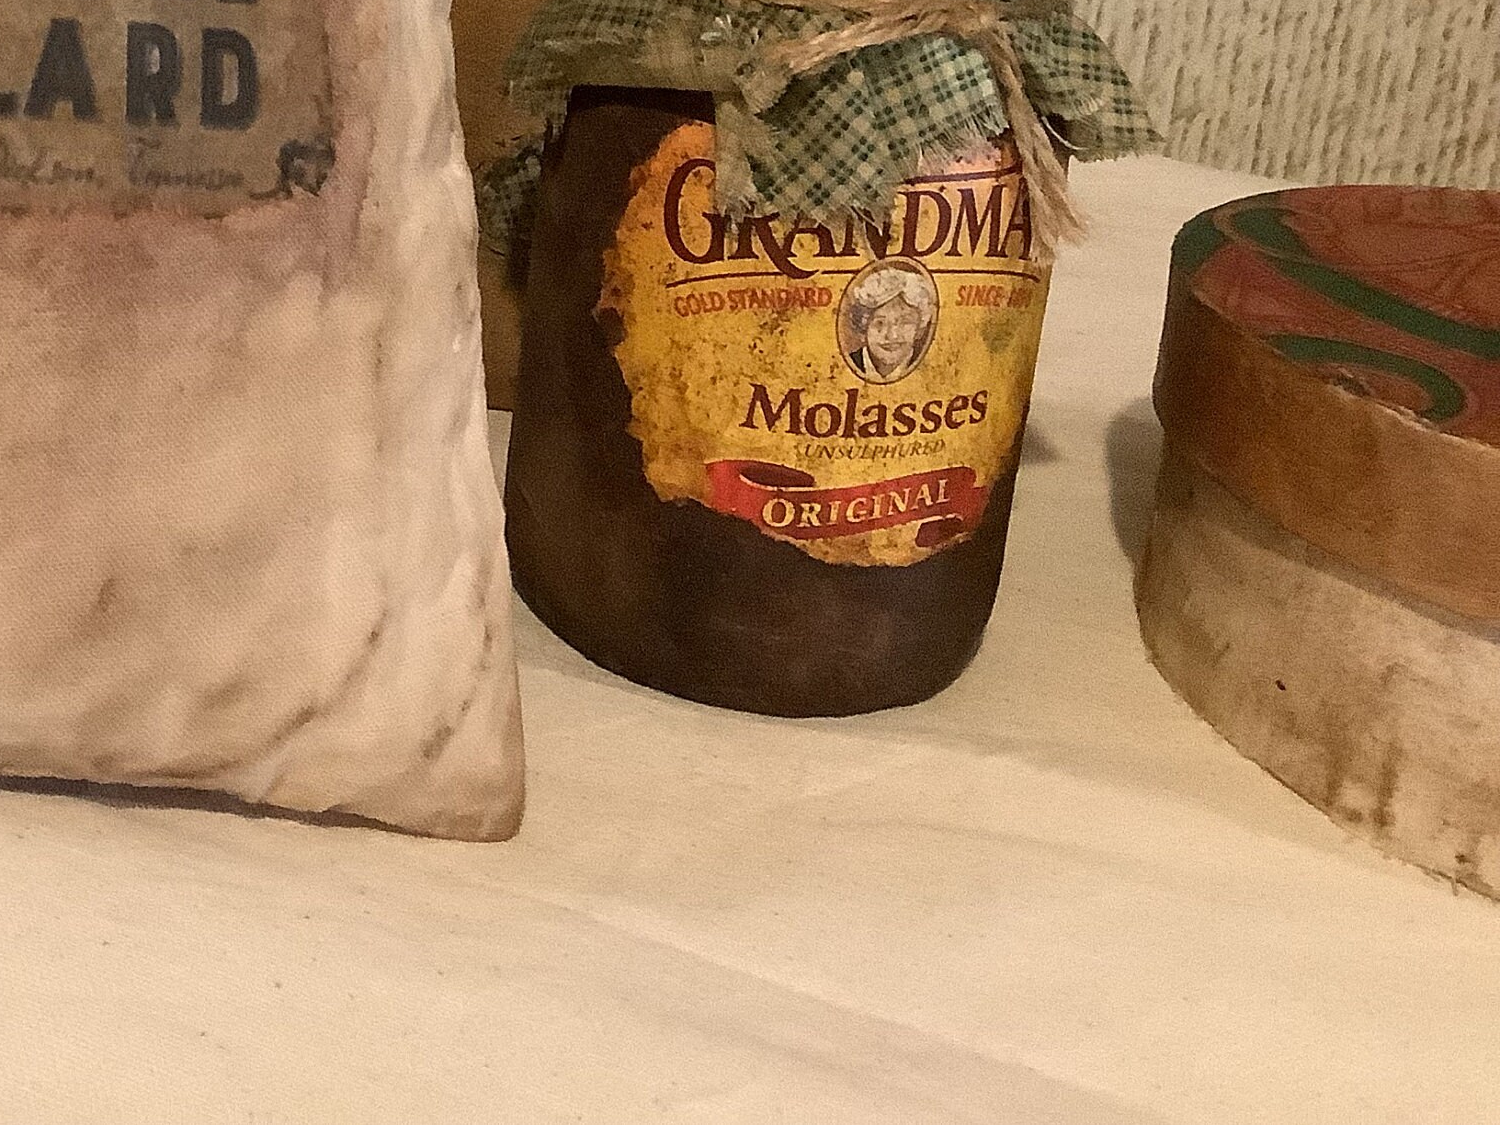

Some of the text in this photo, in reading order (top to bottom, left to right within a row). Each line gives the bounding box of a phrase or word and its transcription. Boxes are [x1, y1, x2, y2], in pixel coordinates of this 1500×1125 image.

[673, 286, 834, 318] GOLD STANDARD
[955, 284, 1006, 308] SINCE
[738, 382, 989, 439] Molasses
[803, 438, 947, 461] UNSULPHURED
[761, 477, 951, 528] ORIGINAL
